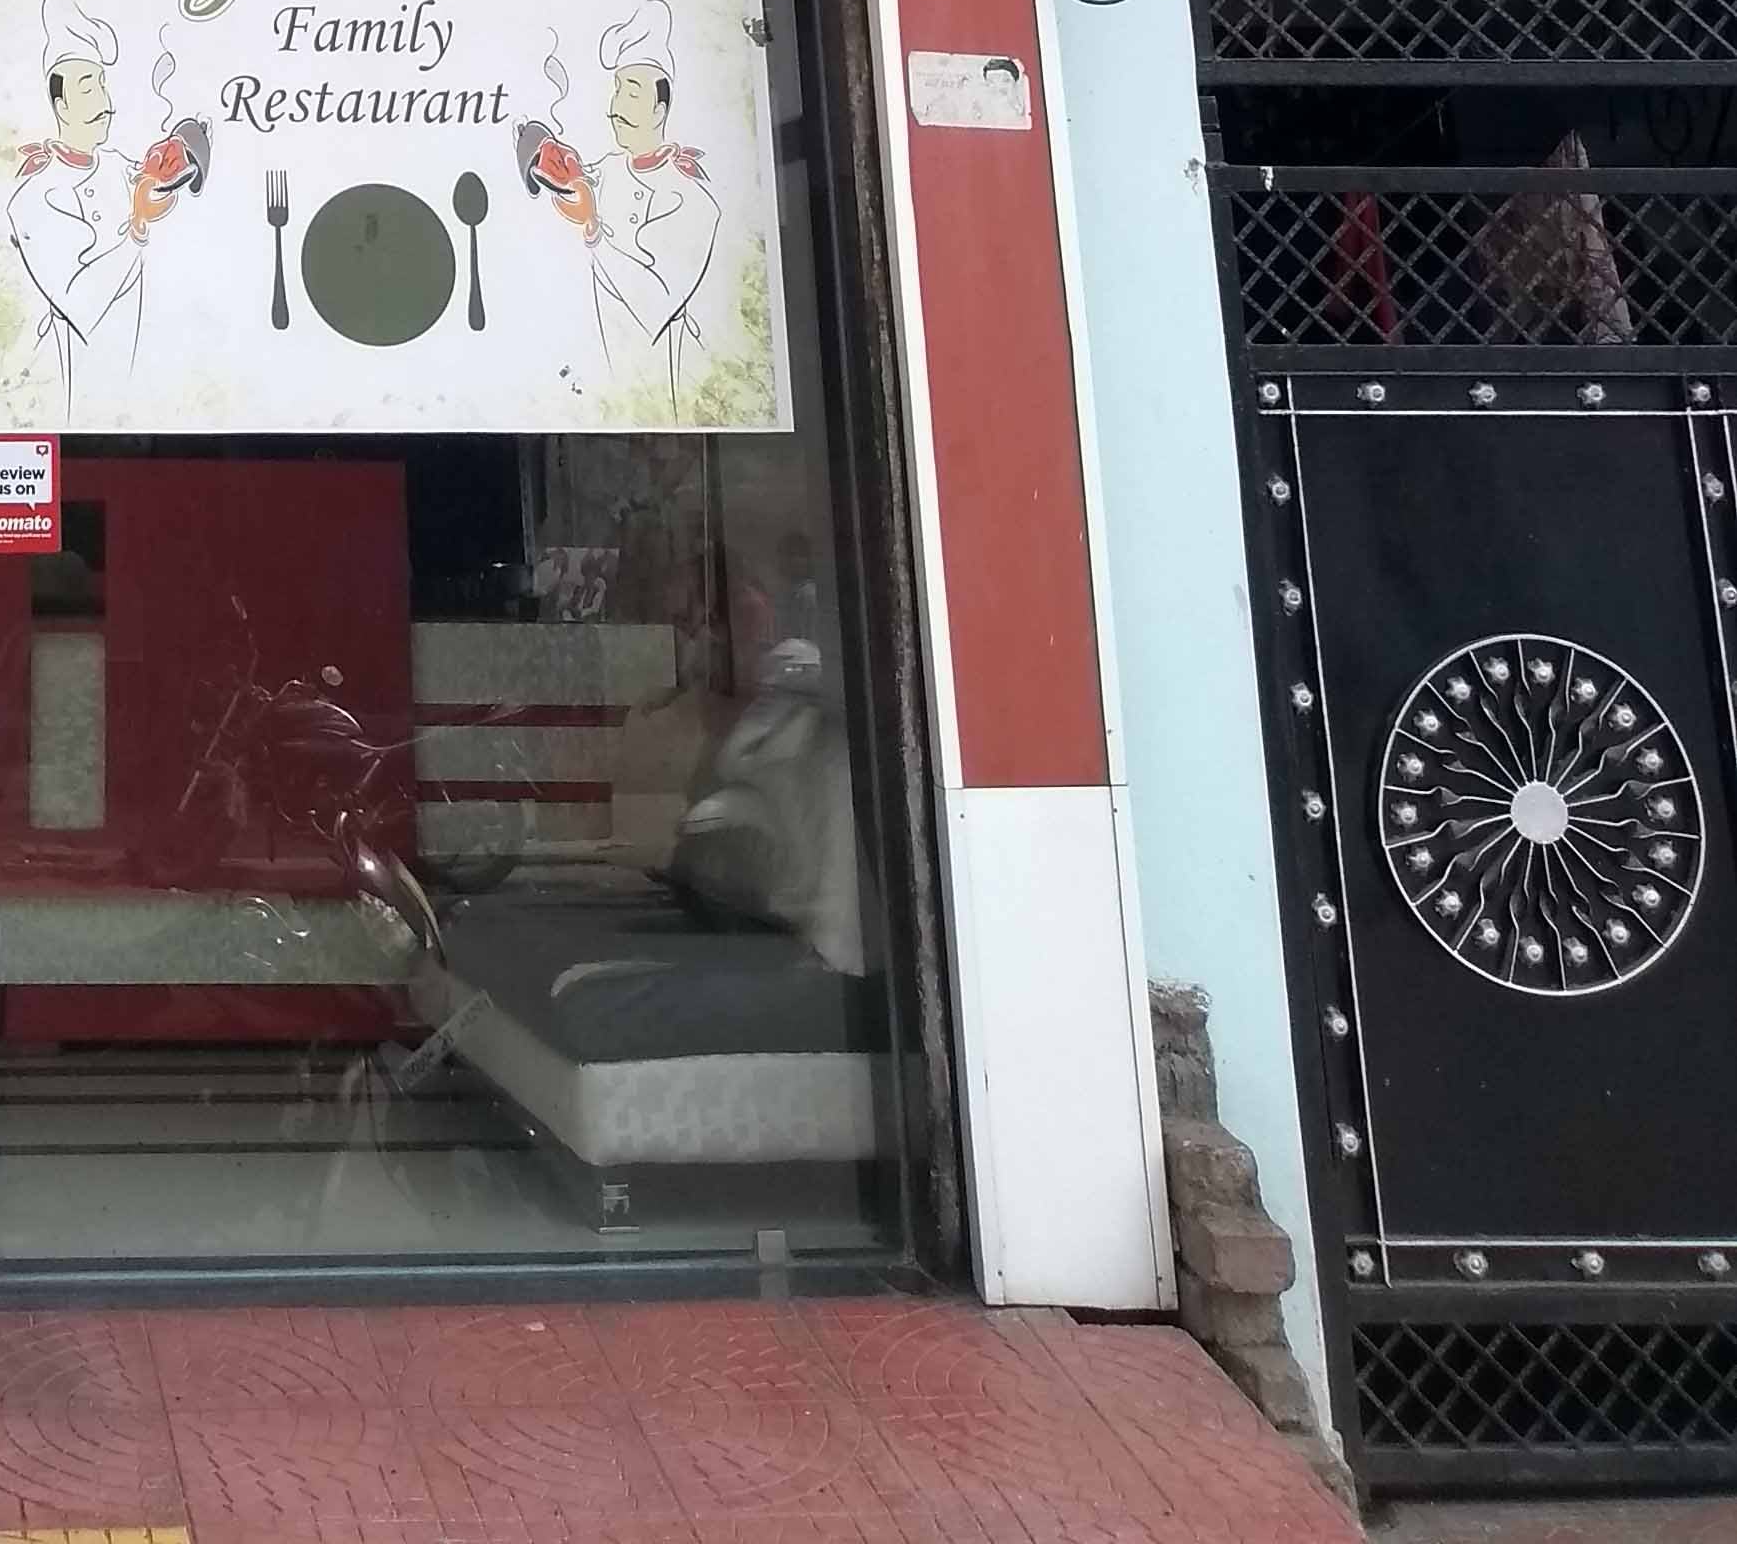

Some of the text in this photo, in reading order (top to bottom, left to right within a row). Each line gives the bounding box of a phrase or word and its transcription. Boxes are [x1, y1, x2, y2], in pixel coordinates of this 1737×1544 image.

[273, 0, 455, 71] Family
[219, 74, 511, 133] Restaurant
[15, 483, 36, 496] on
